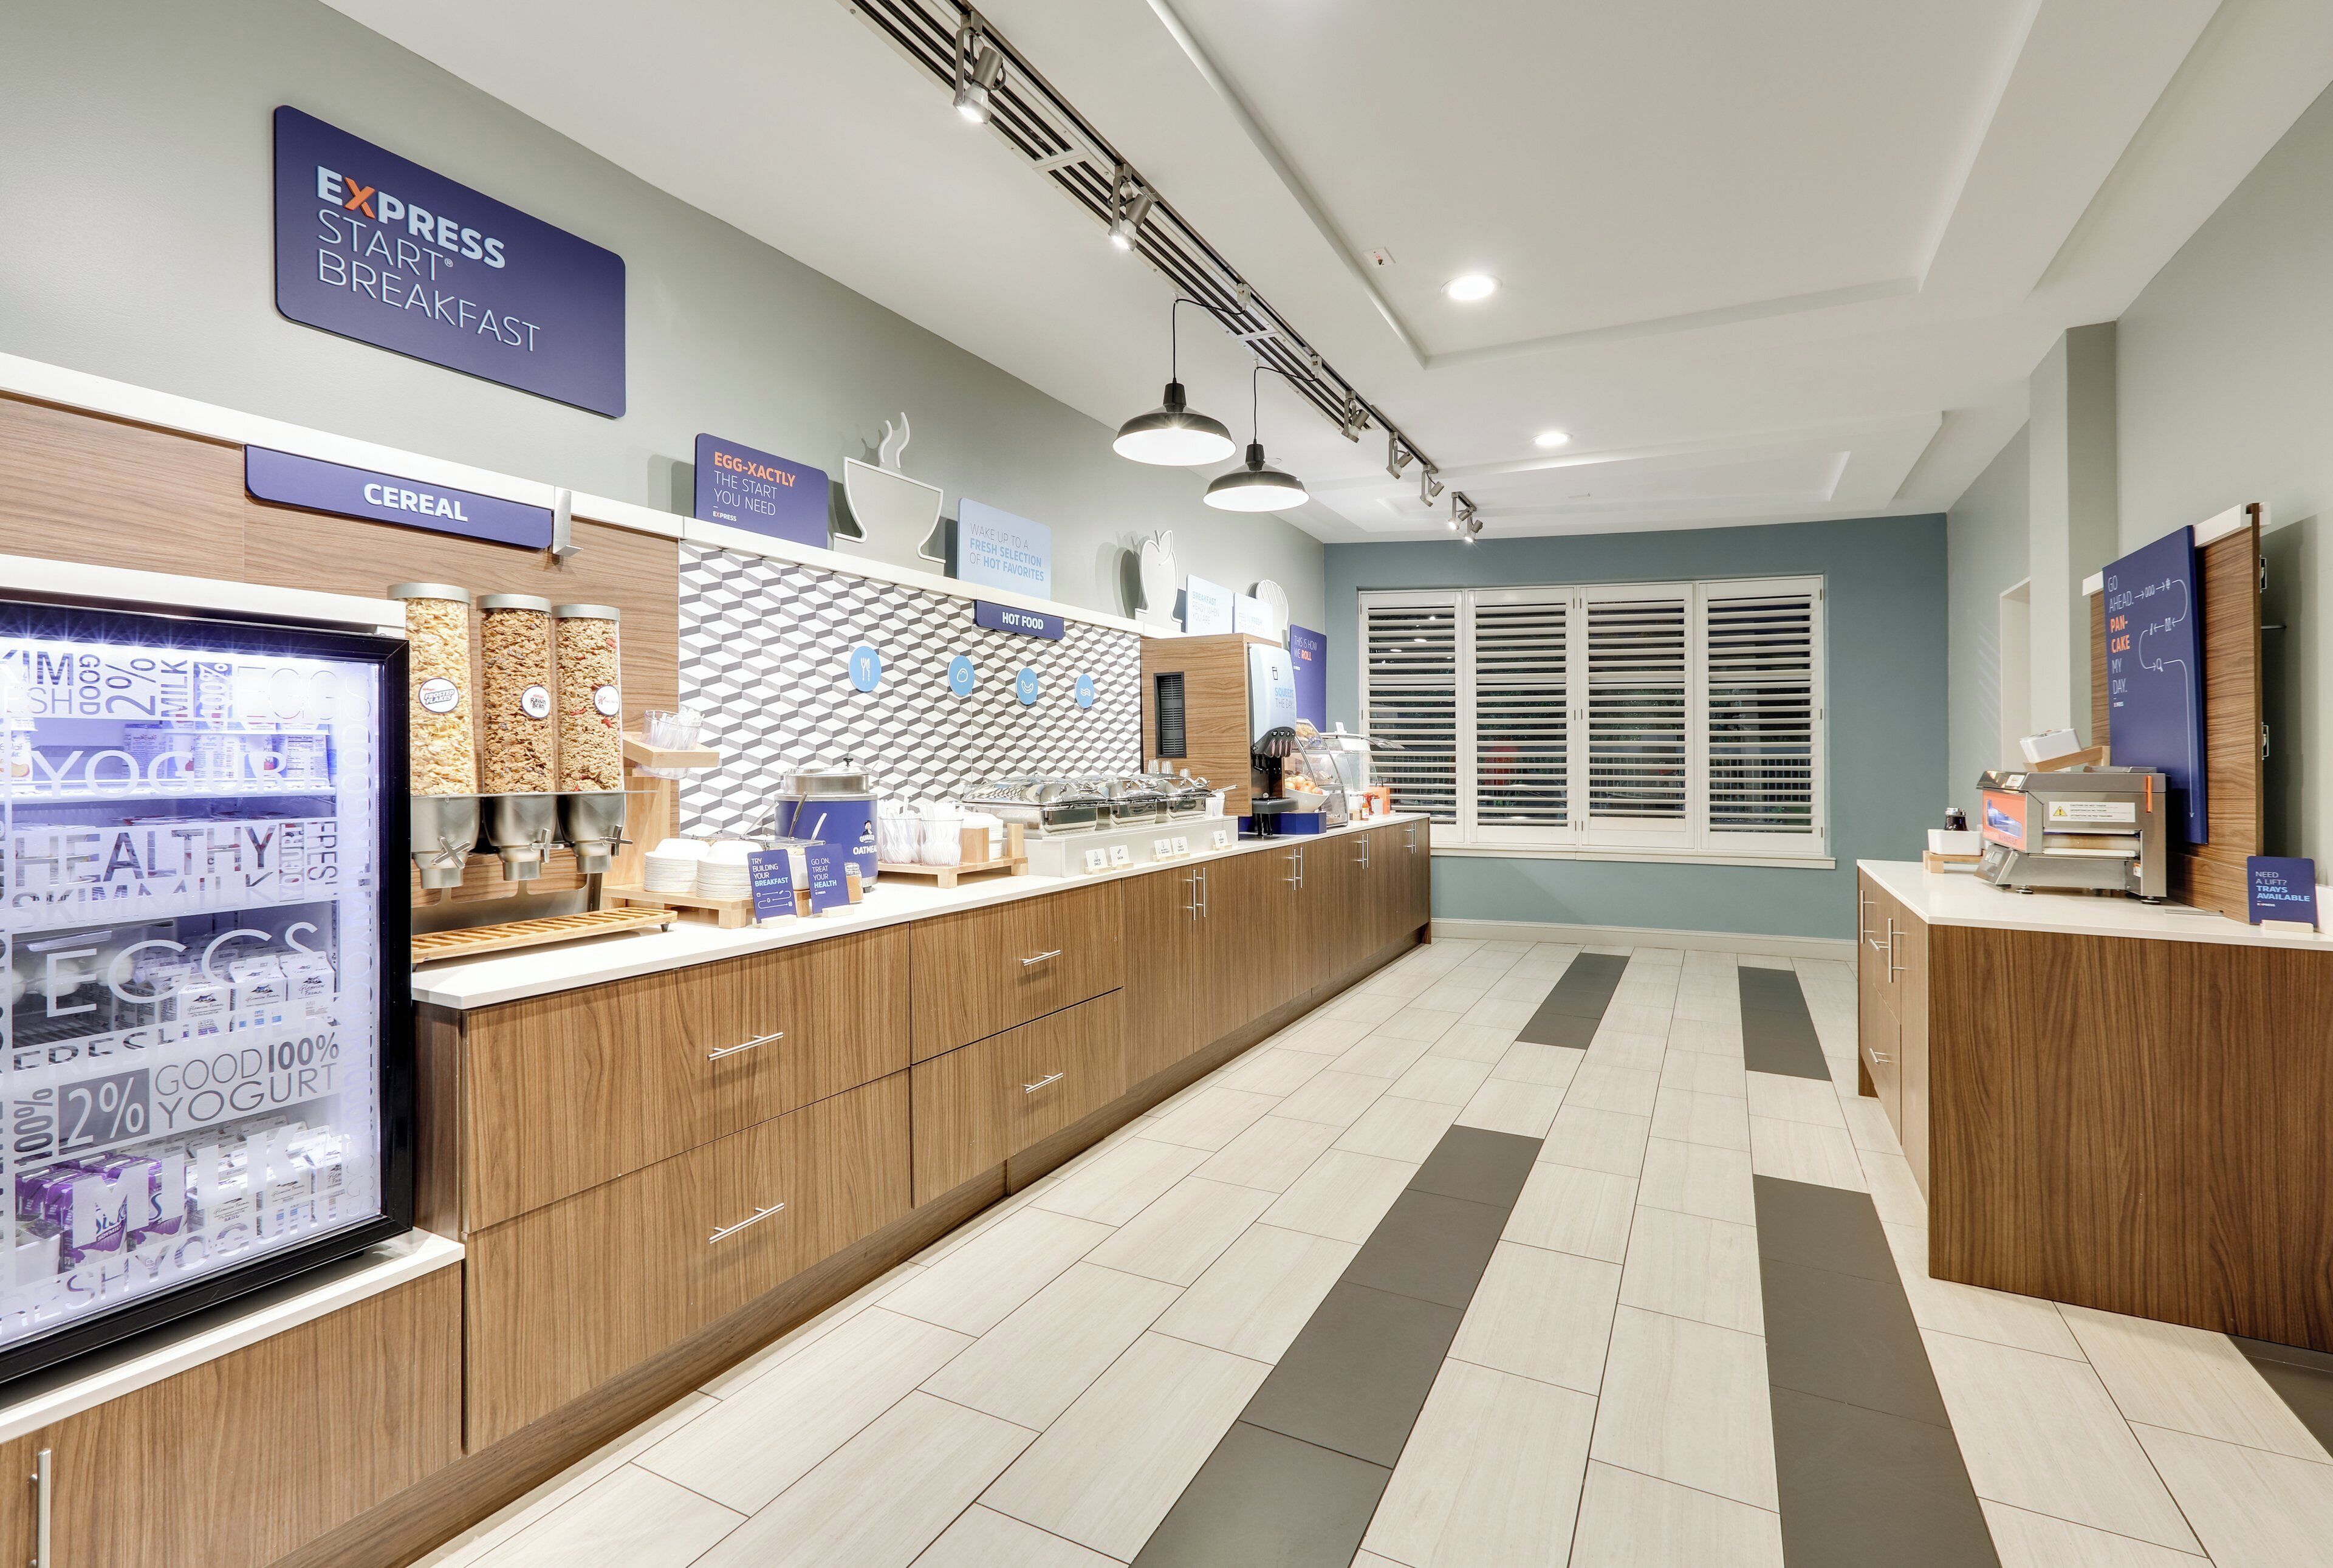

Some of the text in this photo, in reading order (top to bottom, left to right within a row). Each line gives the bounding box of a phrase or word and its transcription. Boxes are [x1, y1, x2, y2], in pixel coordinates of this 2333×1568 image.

[317, 165, 505, 269] EXPRESS
[318, 248, 540, 352] BREAKFAST
[714, 451, 796, 487] EGG-XACTLY
[714, 470, 777, 499] THE START
[363, 483, 468, 522] CEREAL
[714, 488, 776, 515] YOU NEED
[713, 511, 737, 521] EXPRESS
[970, 524, 1029, 550] WAKE UP TO A
[970, 538, 1041, 567] FRESH SELECTION
[970, 552, 1044, 581] OF HOT FAVORITES
[2108, 575, 2118, 592] GO
[1193, 591, 1216, 606] BREAKFAST
[2109, 591, 2134, 612] AHEAD.
[1002, 612, 1044, 630] HOT FOOD
[2110, 614, 2128, 633] PAN-
[1294, 635, 1317, 651] THIS IS HOW
[1294, 648, 1312, 661] WE ROLL
[2111, 634, 2130, 653] CAKE
[2112, 658, 2122, 674] MY
[79, 654, 101, 715] GOOD
[105, 658, 156, 716] 2%
[161, 660, 188, 717] MILK
[199, 663, 230, 718] 100%
[2112, 678, 2128, 694] DAY.
[1275, 698, 1285, 709] THE
[30, 750, 324, 799] YOGURT
[15, 824, 277, 888] HEALTHY
[752, 863, 779, 872] BUILDING
[755, 877, 789, 887] BREAKFAST
[814, 880, 837, 889] HEALTH
[2256, 892, 2311, 902] AVAILABLE
[156, 1032, 340, 1096] GOOD 100%
[157, 1062, 337, 1129] YOGURT
[67, 1077, 145, 1147] 2%
[13, 1088, 53, 1165] 100%
[72, 1121, 304, 1249] MILK
